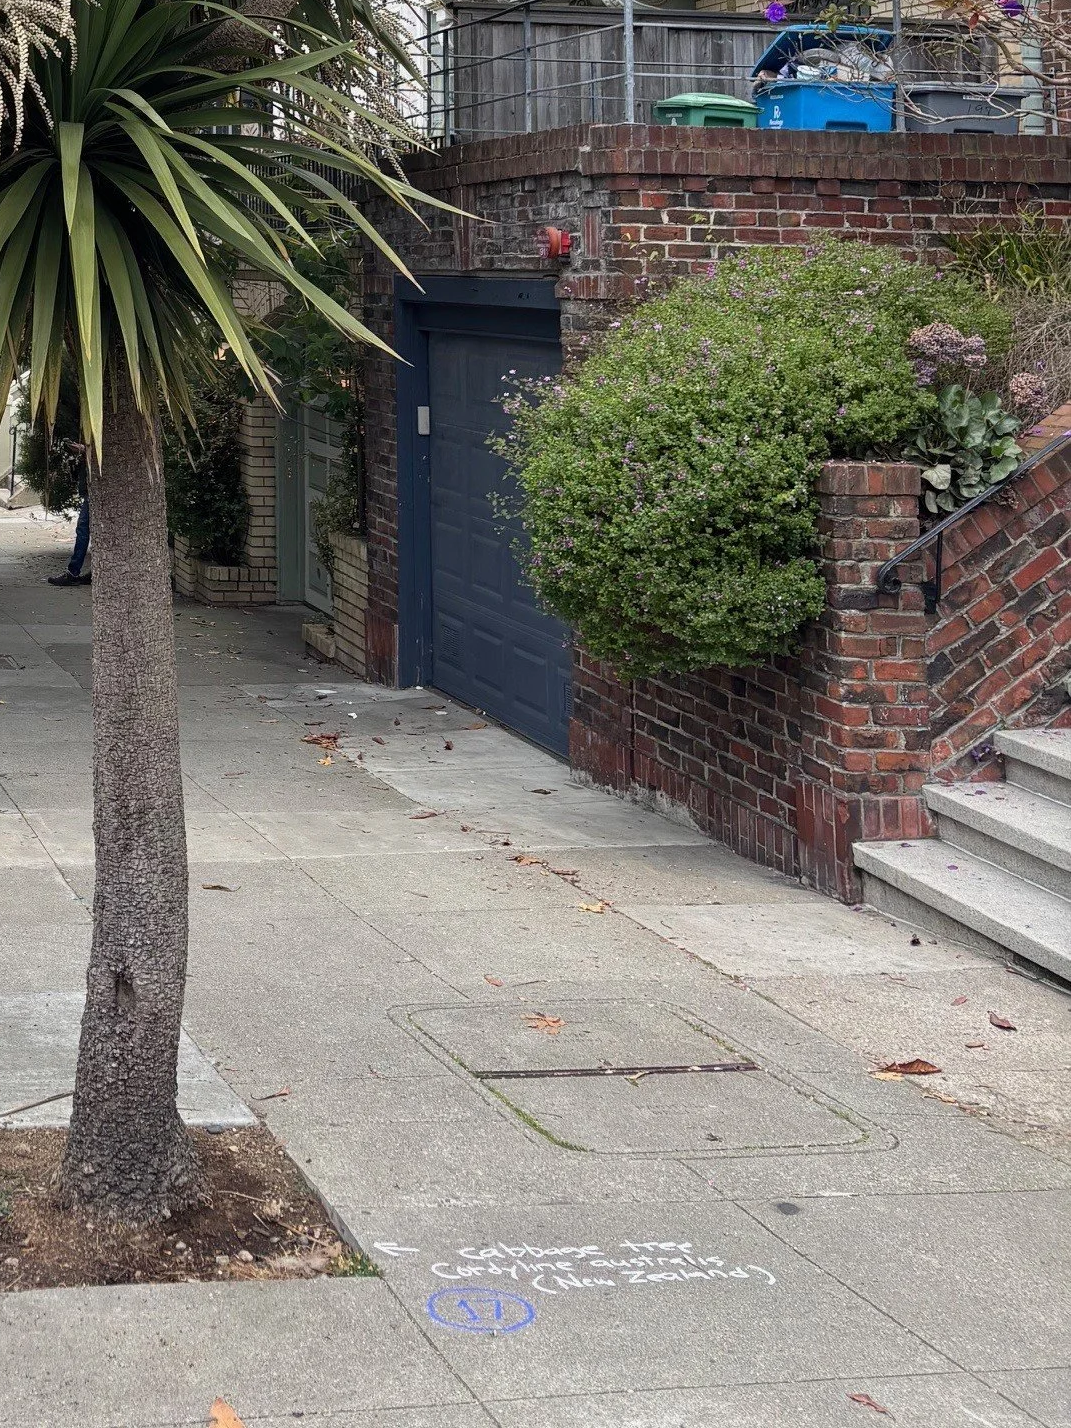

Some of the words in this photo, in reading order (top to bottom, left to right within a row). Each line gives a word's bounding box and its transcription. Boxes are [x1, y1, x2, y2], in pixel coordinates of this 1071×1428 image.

[620, 1239, 693, 1254] tree
[431, 1258, 576, 1280] Cordyline
[590, 1253, 725, 1268] australis
[532, 1272, 617, 1295] (New
[621, 1263, 777, 1286] Zealand)
[456, 1299, 503, 1322] 17
